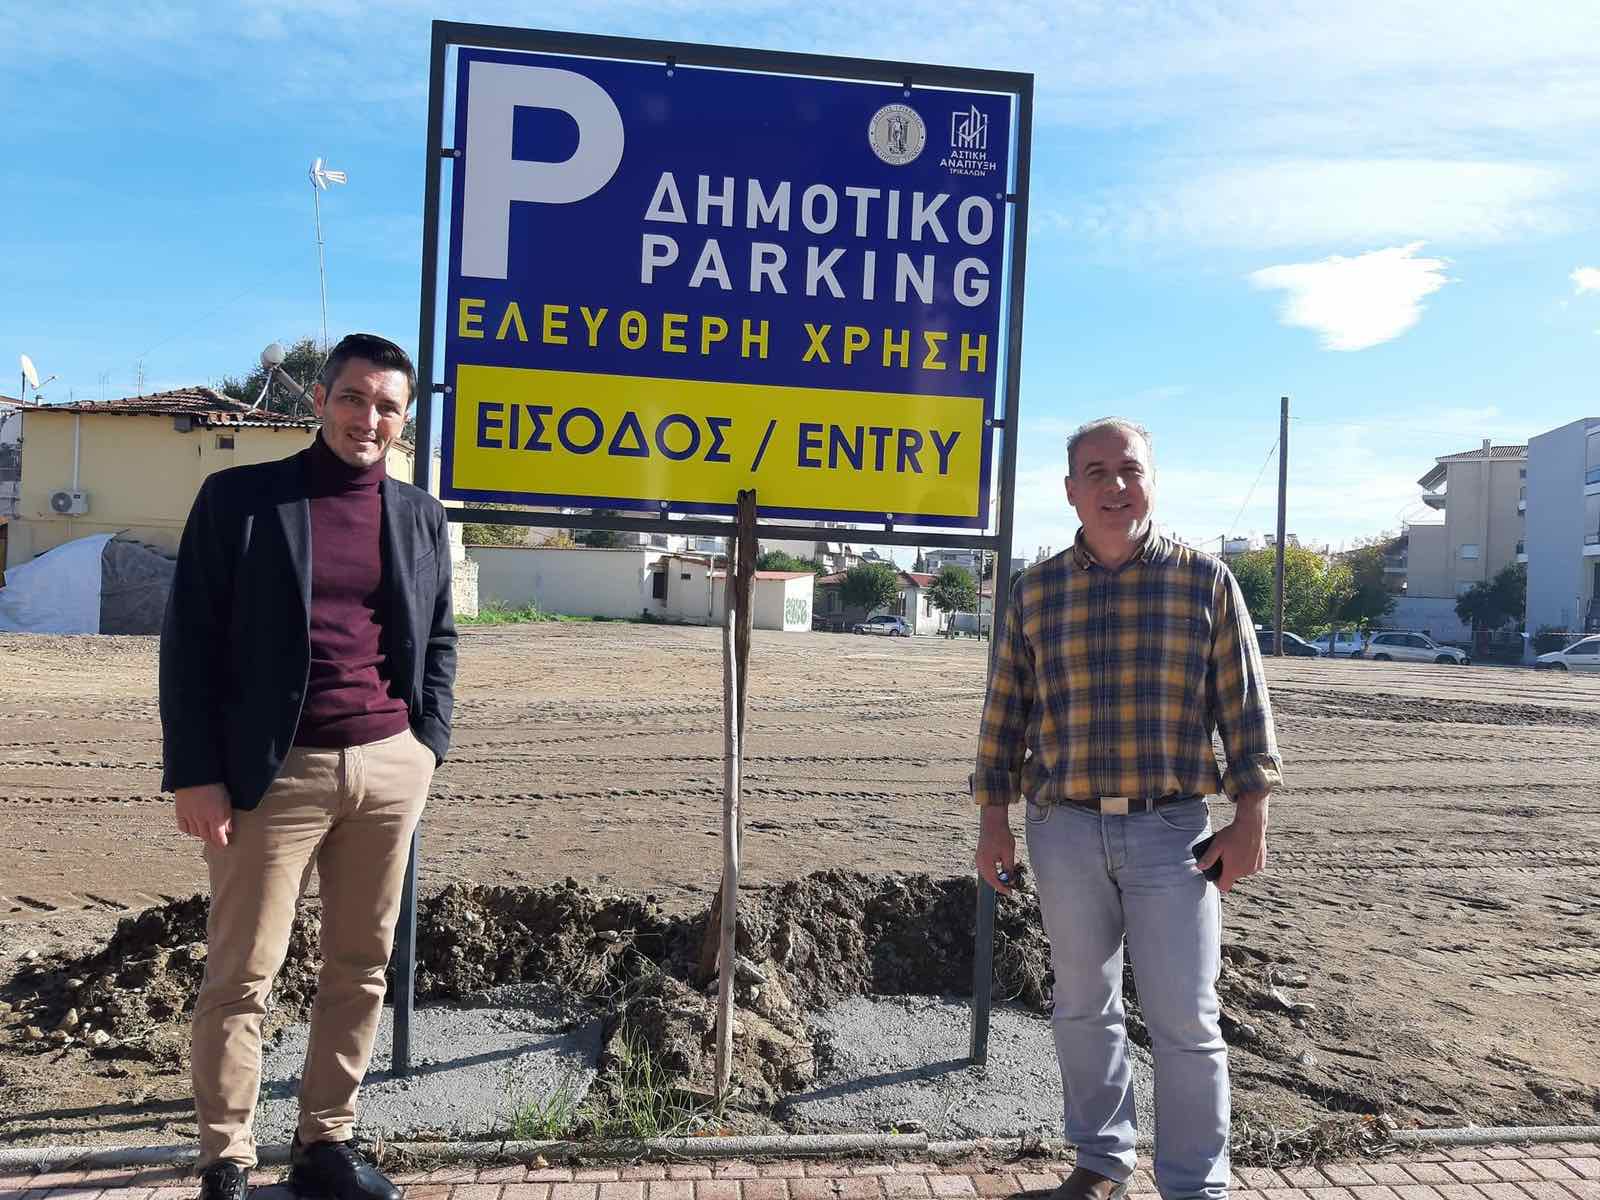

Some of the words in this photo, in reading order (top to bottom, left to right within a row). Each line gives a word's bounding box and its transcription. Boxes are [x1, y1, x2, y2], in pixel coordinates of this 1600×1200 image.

[461, 61, 624, 279] P
[940, 158, 997, 170] ΑΝΑΠΤΥΞΗ
[951, 150, 986, 160] ΑΣΤΙΚΗ
[645, 172, 993, 244] ΔΗΜΟΤΙΚΟ
[641, 234, 989, 306] PARKING
[458, 299, 768, 358] ΕΛΕΥΘΕΡΗ
[803, 324, 986, 372] ΧΡΗΣΗ
[476, 401, 732, 463] ΕΙΣΟΔΟΣ
[750, 420, 776, 472] /
[798, 423, 961, 475] ENTRY
